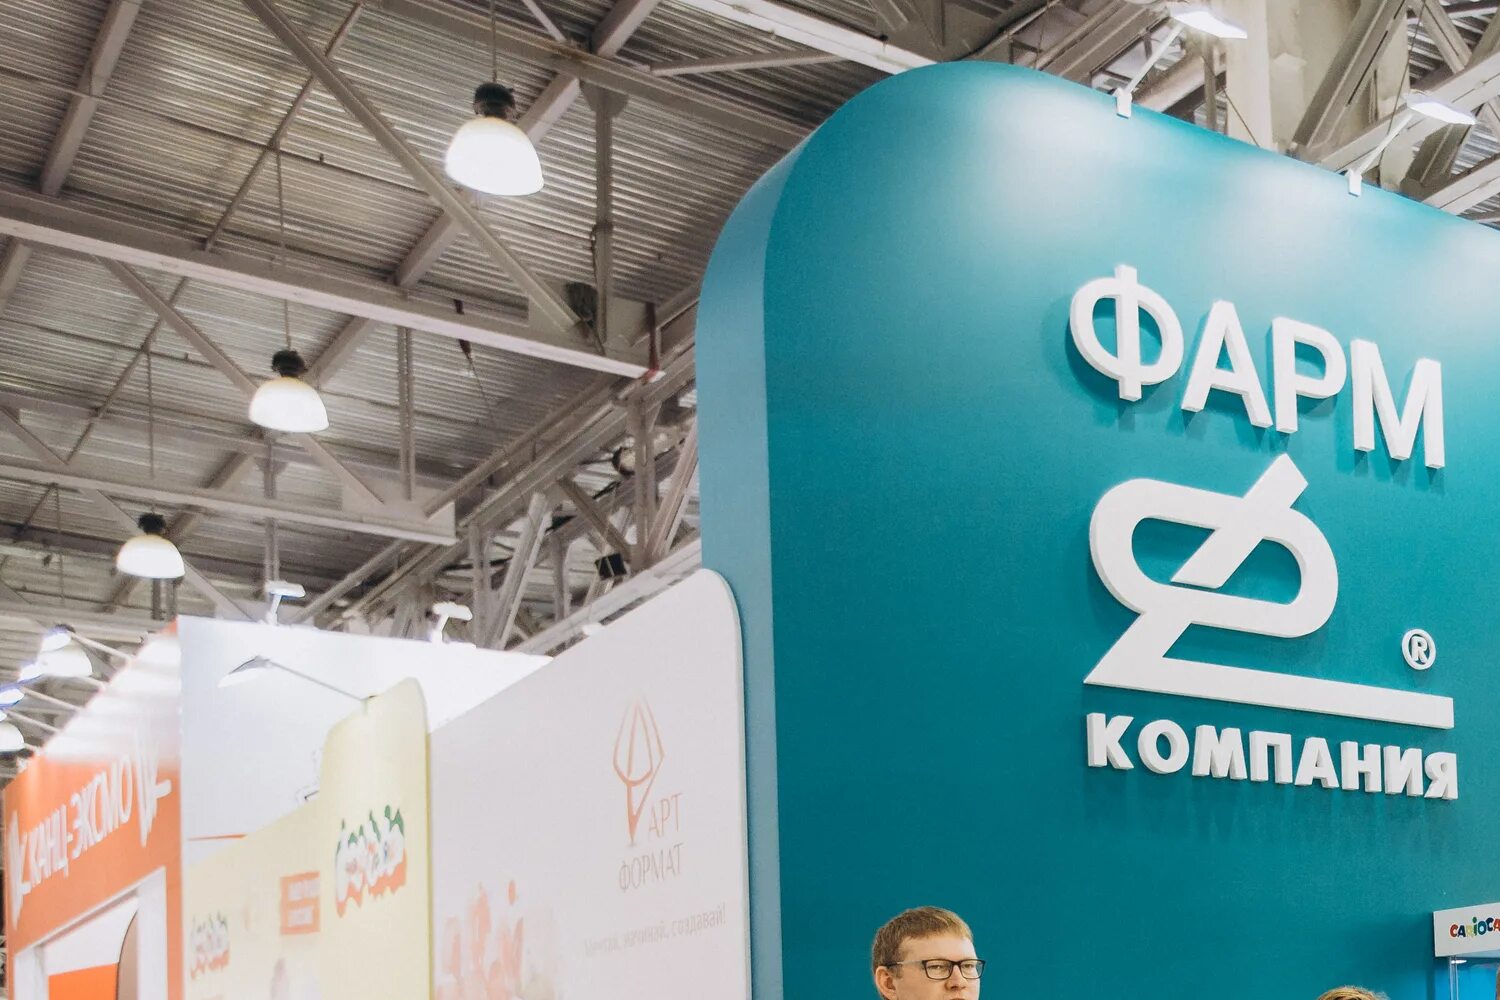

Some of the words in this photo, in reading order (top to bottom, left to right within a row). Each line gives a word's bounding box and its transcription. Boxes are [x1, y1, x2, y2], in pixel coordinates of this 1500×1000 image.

[1070, 264, 1445, 468] ФАРМ
[1087, 712, 1458, 800] КОМПАНИЯ
[648, 793, 682, 838] АРТ
[619, 843, 683, 893] ФОРМАТ
[672, 903, 725, 937] создавай!
